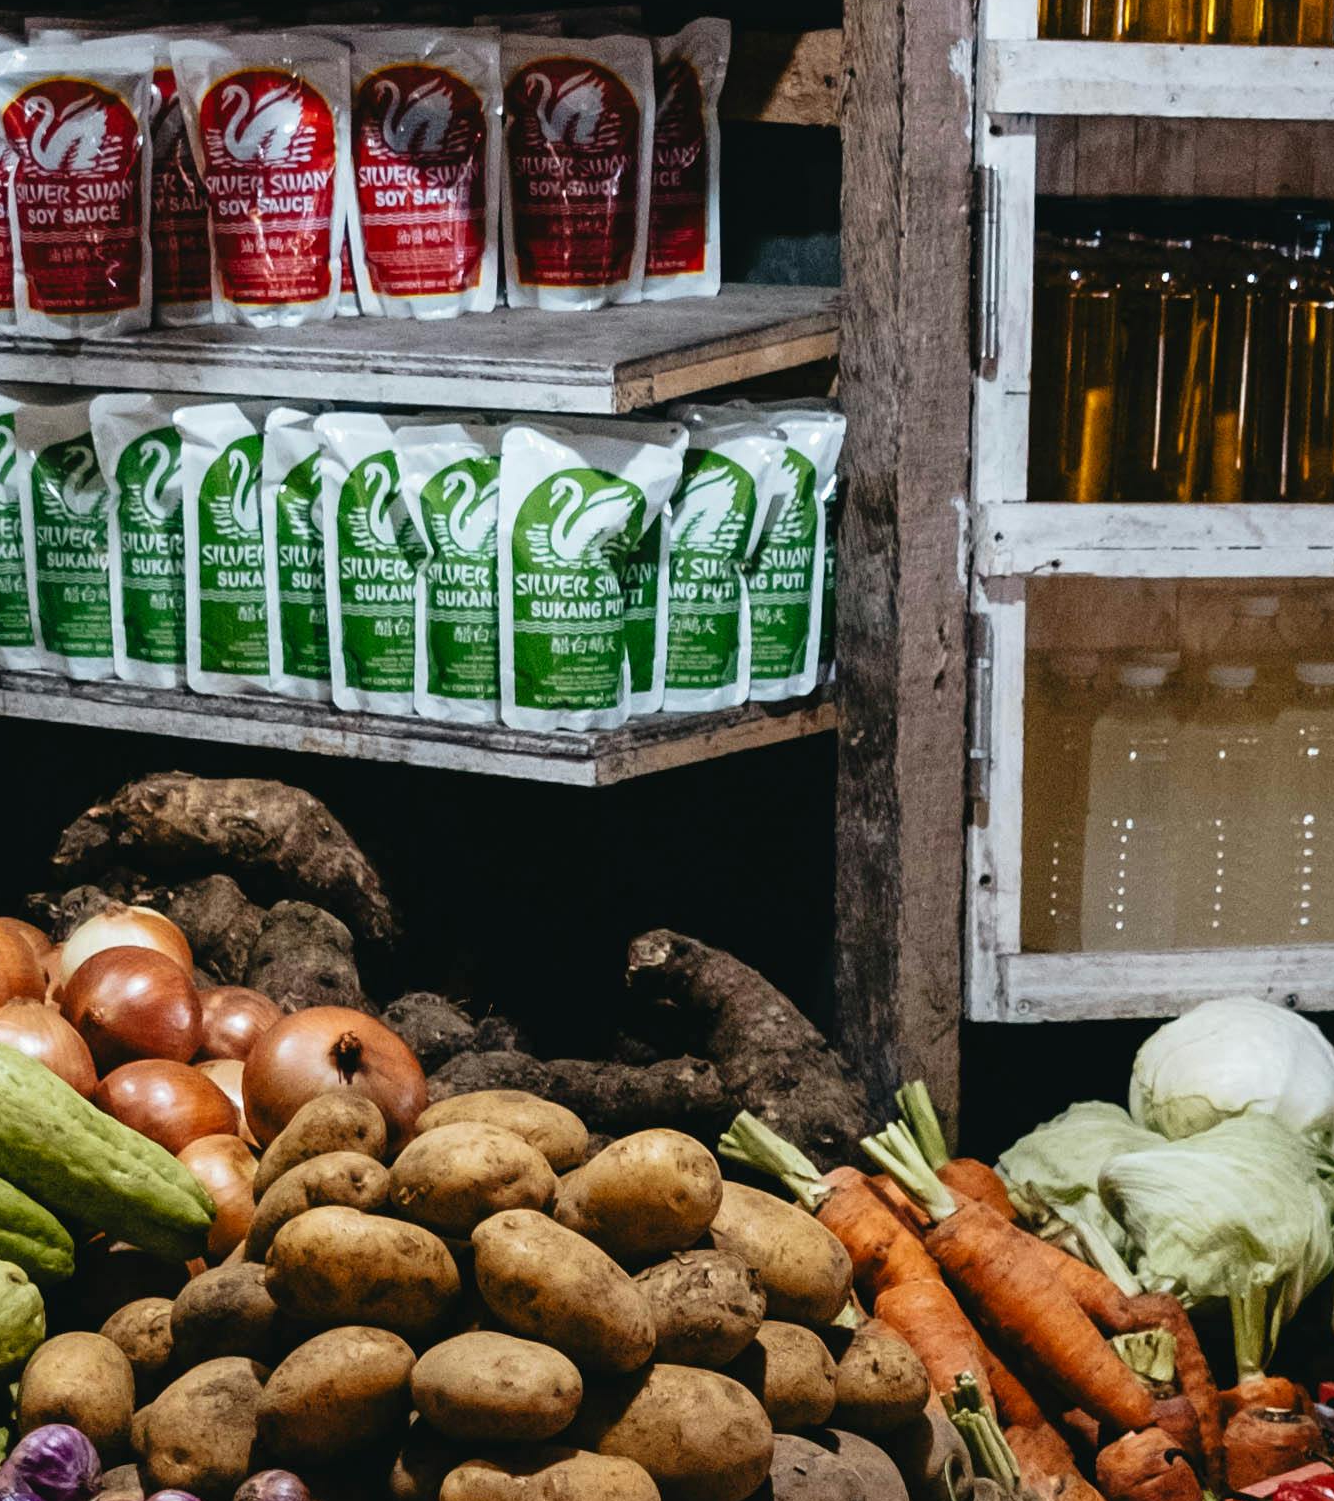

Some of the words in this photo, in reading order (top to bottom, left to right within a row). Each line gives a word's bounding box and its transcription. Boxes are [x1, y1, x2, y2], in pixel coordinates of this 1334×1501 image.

[205, 174, 262, 198] SILVER
[269, 169, 329, 195] SWAN
[358, 164, 422, 189] SILVER
[425, 162, 480, 185] SWAN
[76, 179, 134, 205] SWAN
[374, 189, 406, 208] SOY
[412, 184, 470, 207] SAUCE
[528, 180, 561, 197] SOY
[27, 208, 56, 225] SOY
[64, 203, 122, 225] SAUCE
[218, 199, 251, 217] SOY
[259, 195, 315, 214] SAUCE
[37, 524, 98, 549] SILVER
[131, 558, 186, 576] SUKAN
[340, 557, 416, 581] SILVER
[759, 546, 812, 570] SWAN
[216, 570, 265, 589] SUKA
[291, 570, 324, 587] SUK
[427, 562, 491, 588] SILVER
[514, 572, 588, 599] SILVER
[772, 571, 805, 591] PUTI
[702, 579, 735, 603] PUTI
[530, 600, 602, 620] SUKANG
[604, 599, 624, 618] PUT
